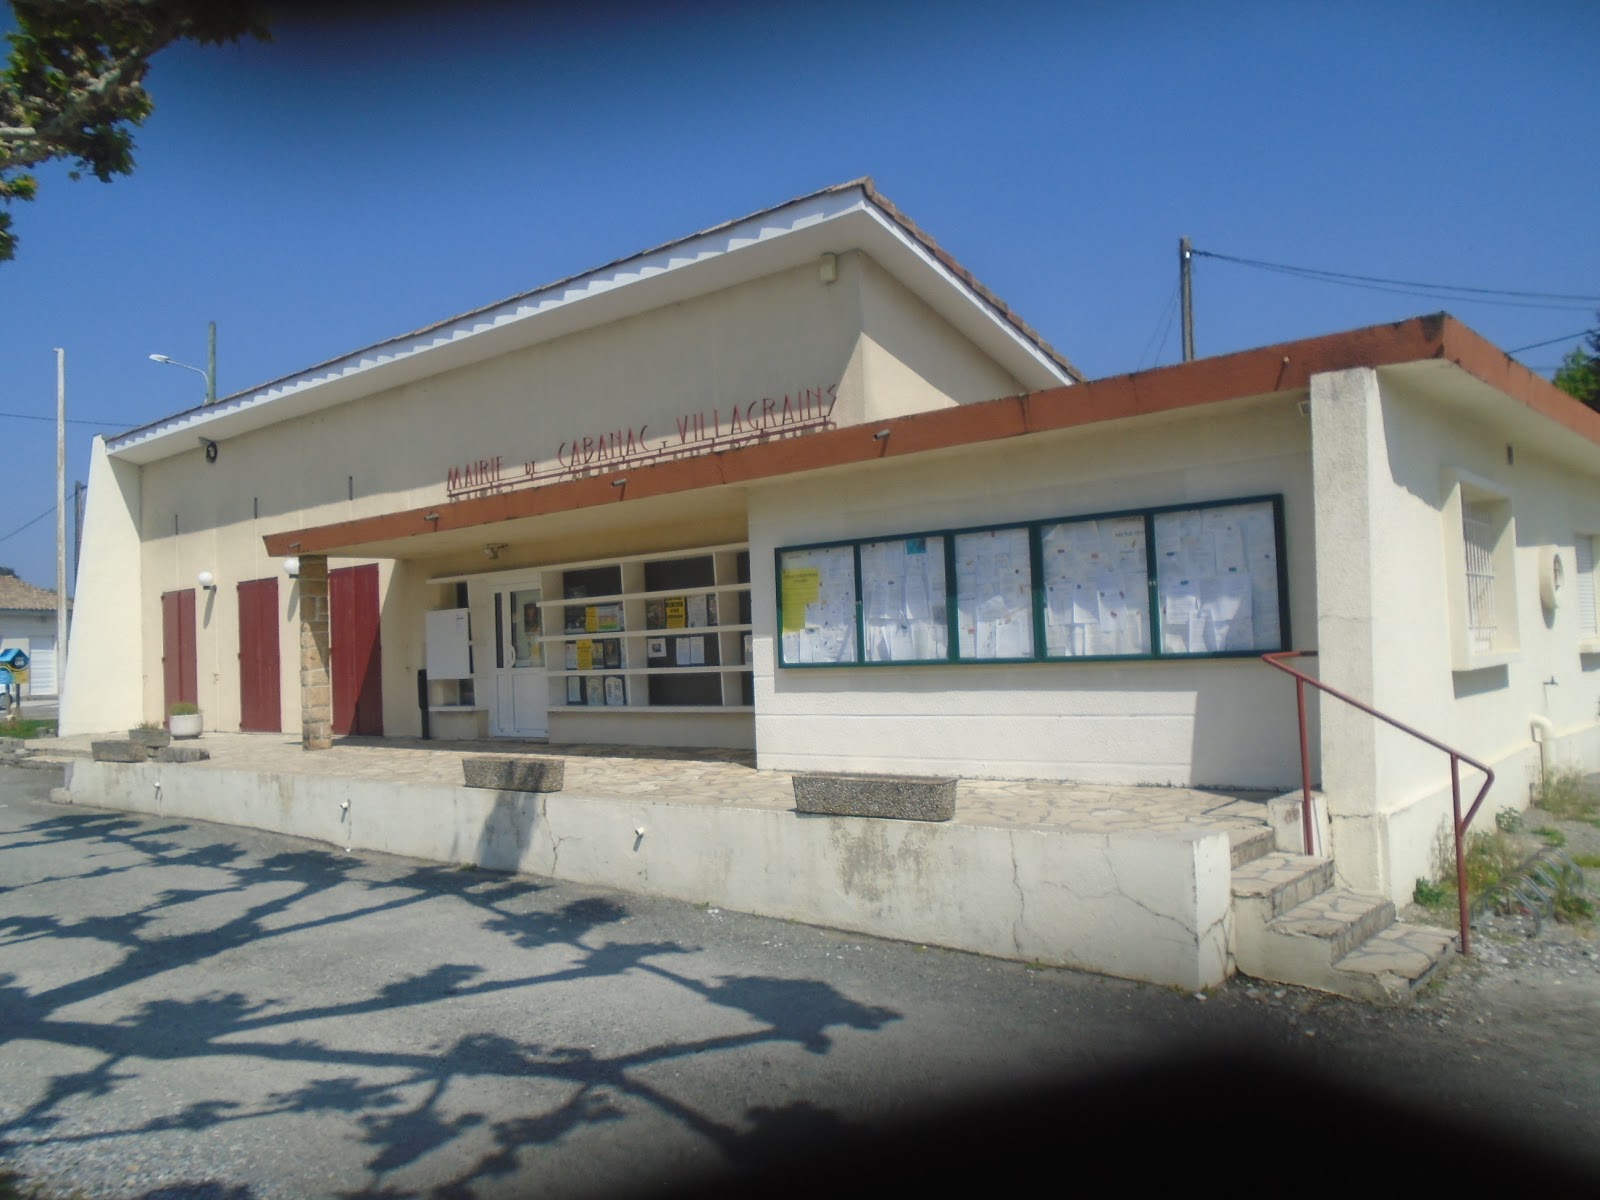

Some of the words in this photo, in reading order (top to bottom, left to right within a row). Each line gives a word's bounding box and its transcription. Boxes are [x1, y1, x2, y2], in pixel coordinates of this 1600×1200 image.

[446, 455, 503, 491] MAIRIE
[557, 424, 648, 467] CABANAC
[676, 384, 837, 444] VILLAGRAINS
